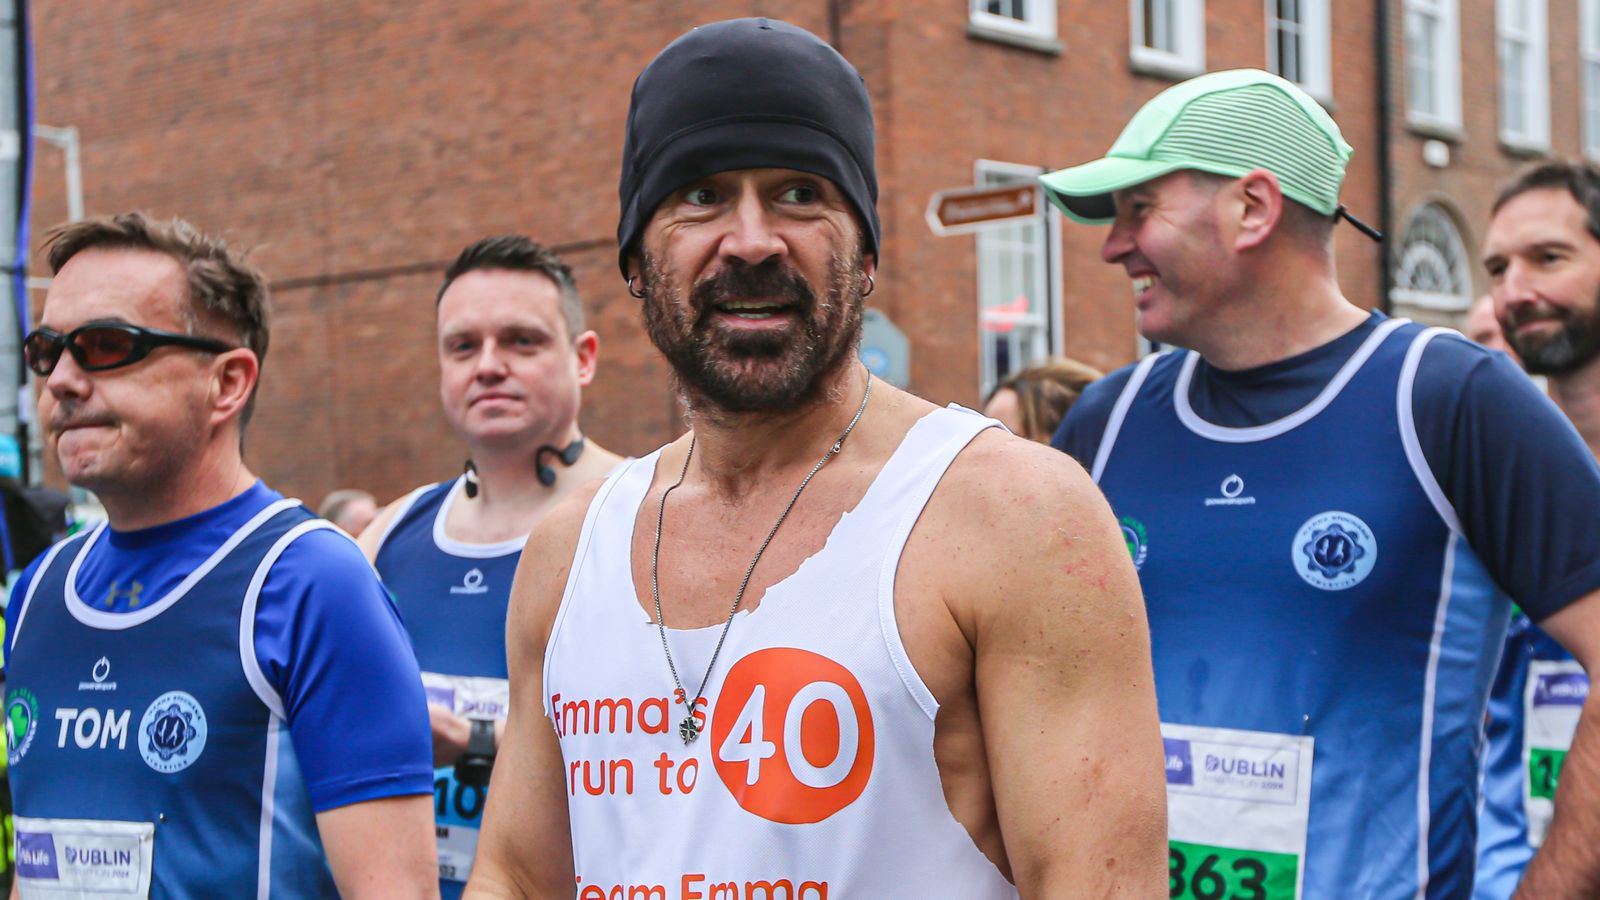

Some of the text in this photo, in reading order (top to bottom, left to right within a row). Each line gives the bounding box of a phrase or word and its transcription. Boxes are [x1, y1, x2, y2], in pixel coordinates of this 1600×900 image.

[55, 707, 131, 750] TOM
[552, 688, 708, 739] Emma's
[719, 681, 860, 788] 40
[570, 751, 699, 796] run to
[1206, 754, 1284, 778] DUBLIN
[65, 846, 131, 865] DUBLIN
[576, 876, 667, 900] eam
